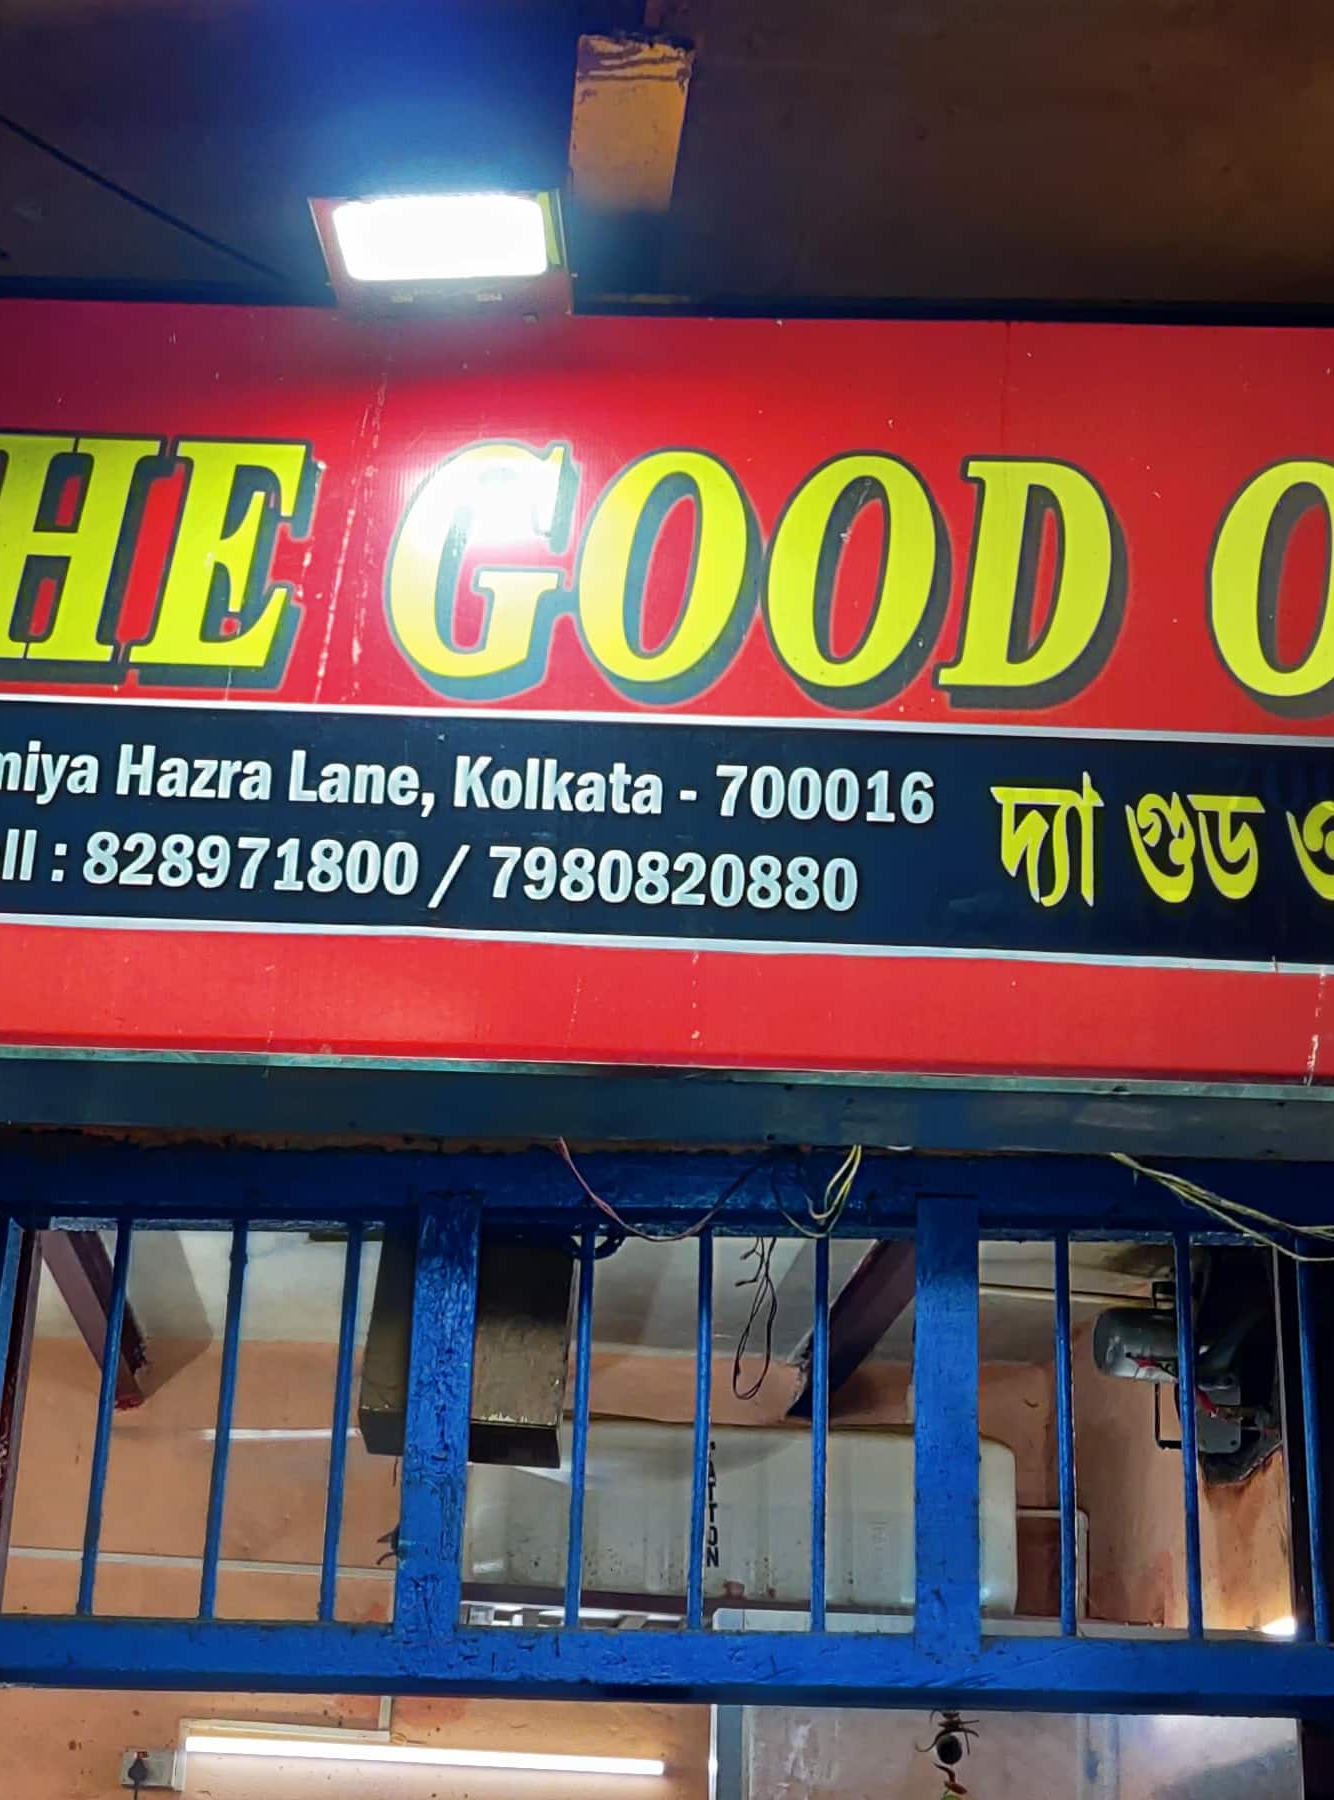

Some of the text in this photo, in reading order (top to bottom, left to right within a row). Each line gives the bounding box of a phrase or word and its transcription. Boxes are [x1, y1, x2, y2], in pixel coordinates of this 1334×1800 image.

[385, 440, 1114, 690] GOOD
[116, 743, 272, 801] Hazra
[289, 750, 436, 818] Lane,
[453, 754, 664, 816] Kolkata
[678, 789, 698, 802] -
[715, 764, 935, 825] 700016
[51, 842, 67, 882] :
[82, 831, 420, 896] 828971800
[427, 844, 470, 908] /
[489, 845, 859, 912] 7980820880
[989, 771, 1105, 908] দ্যা
[1125, 792, 1266, 904] গুড
